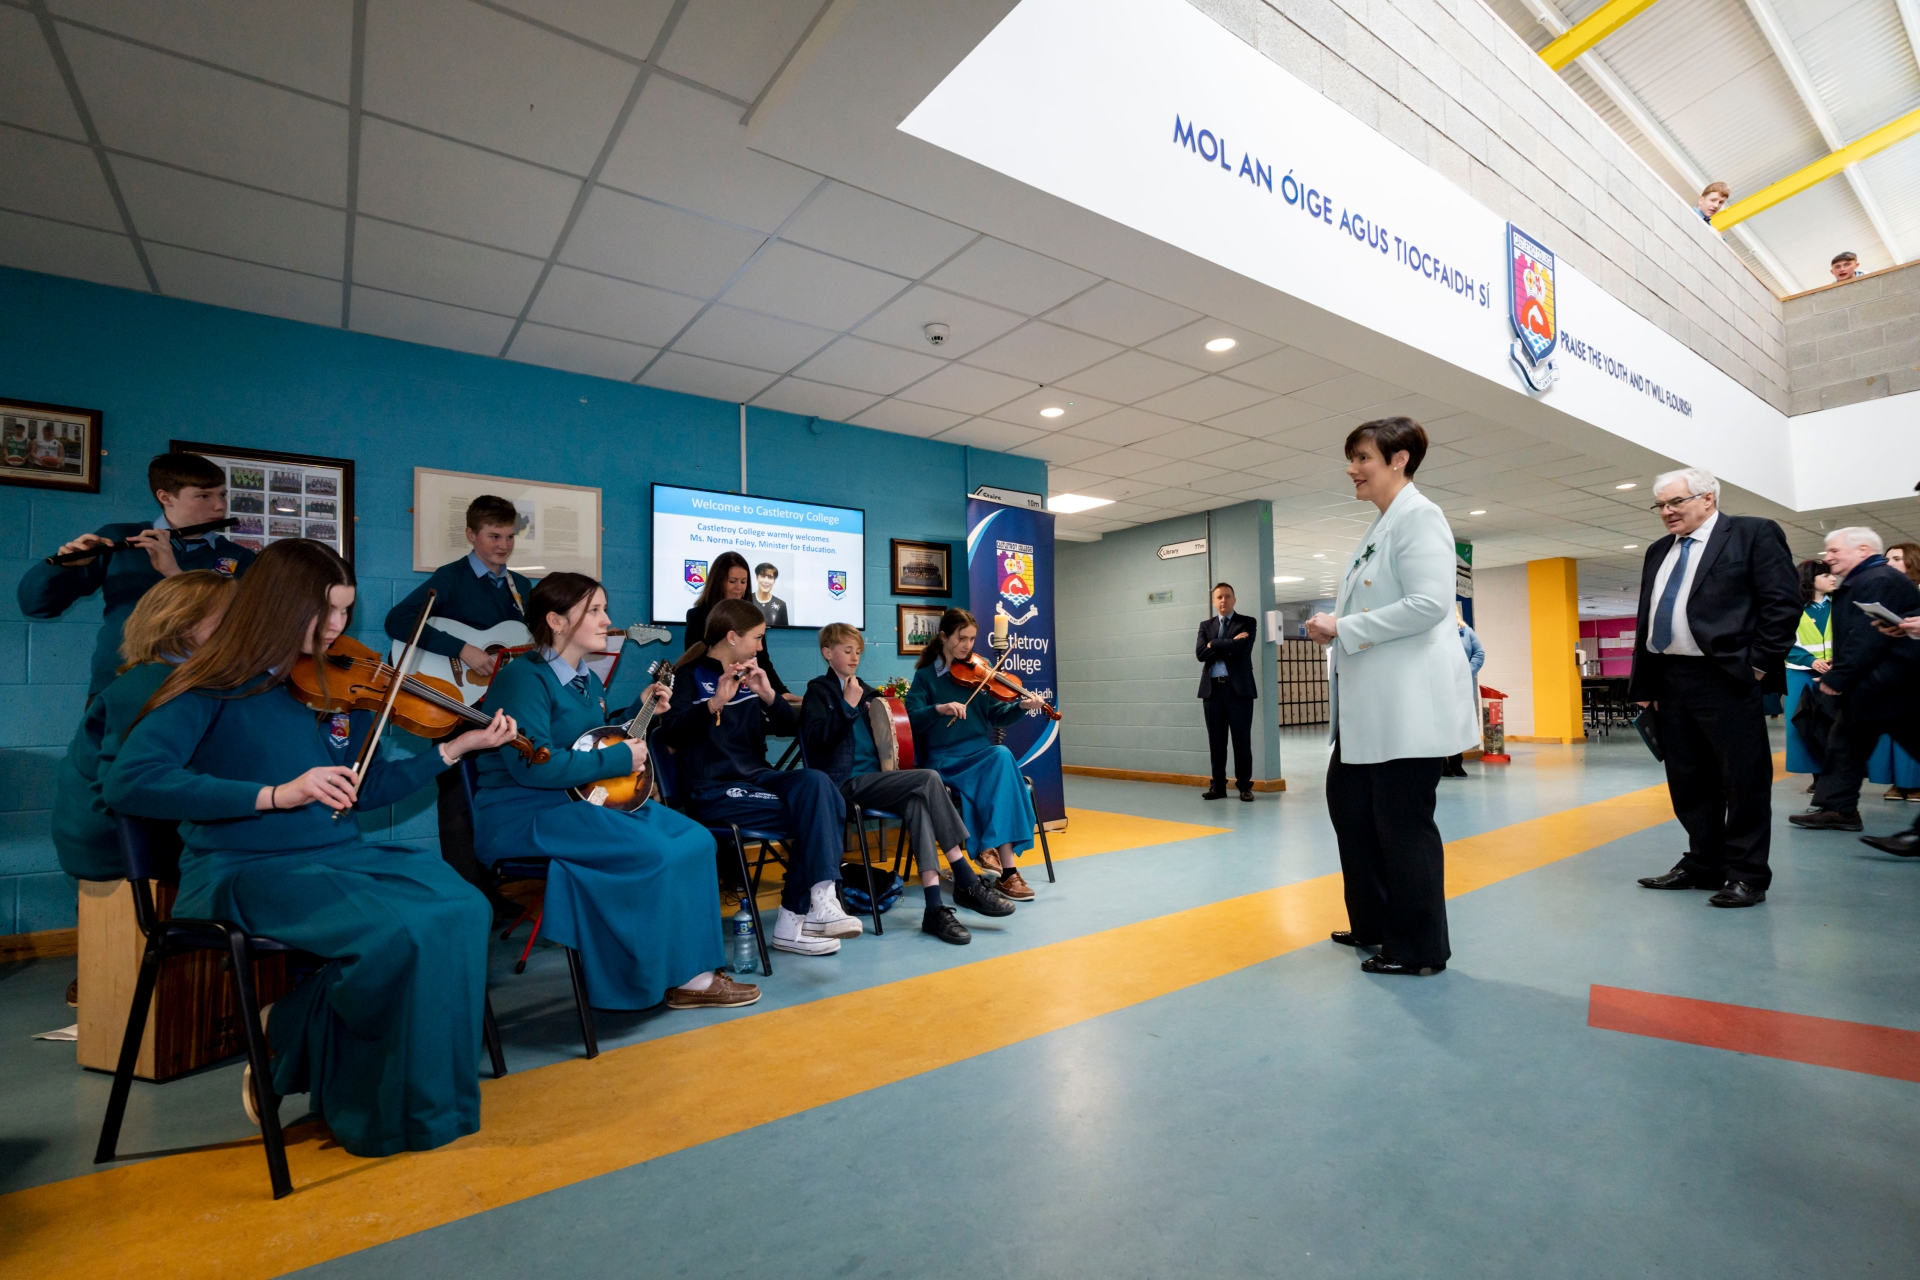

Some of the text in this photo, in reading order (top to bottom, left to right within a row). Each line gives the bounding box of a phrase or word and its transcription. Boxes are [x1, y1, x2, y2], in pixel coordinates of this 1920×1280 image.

[1173, 112, 1490, 309] MOL AN ÓIGE AGUS TIOCFAIDH SÍ
[1560, 330, 1693, 418] PRAISE THE YOUTH AND IT WILL FLOURISH
[691, 497, 840, 526] Welcome to Castletroy College
[1027, 499, 1040, 508] 10m
[690, 534, 838, 555] Ms. Norma Foley, Minister for Education.
[697, 523, 830, 543] Castletroy College warmly welcomes
[988, 631, 1049, 654] Ctletroy
